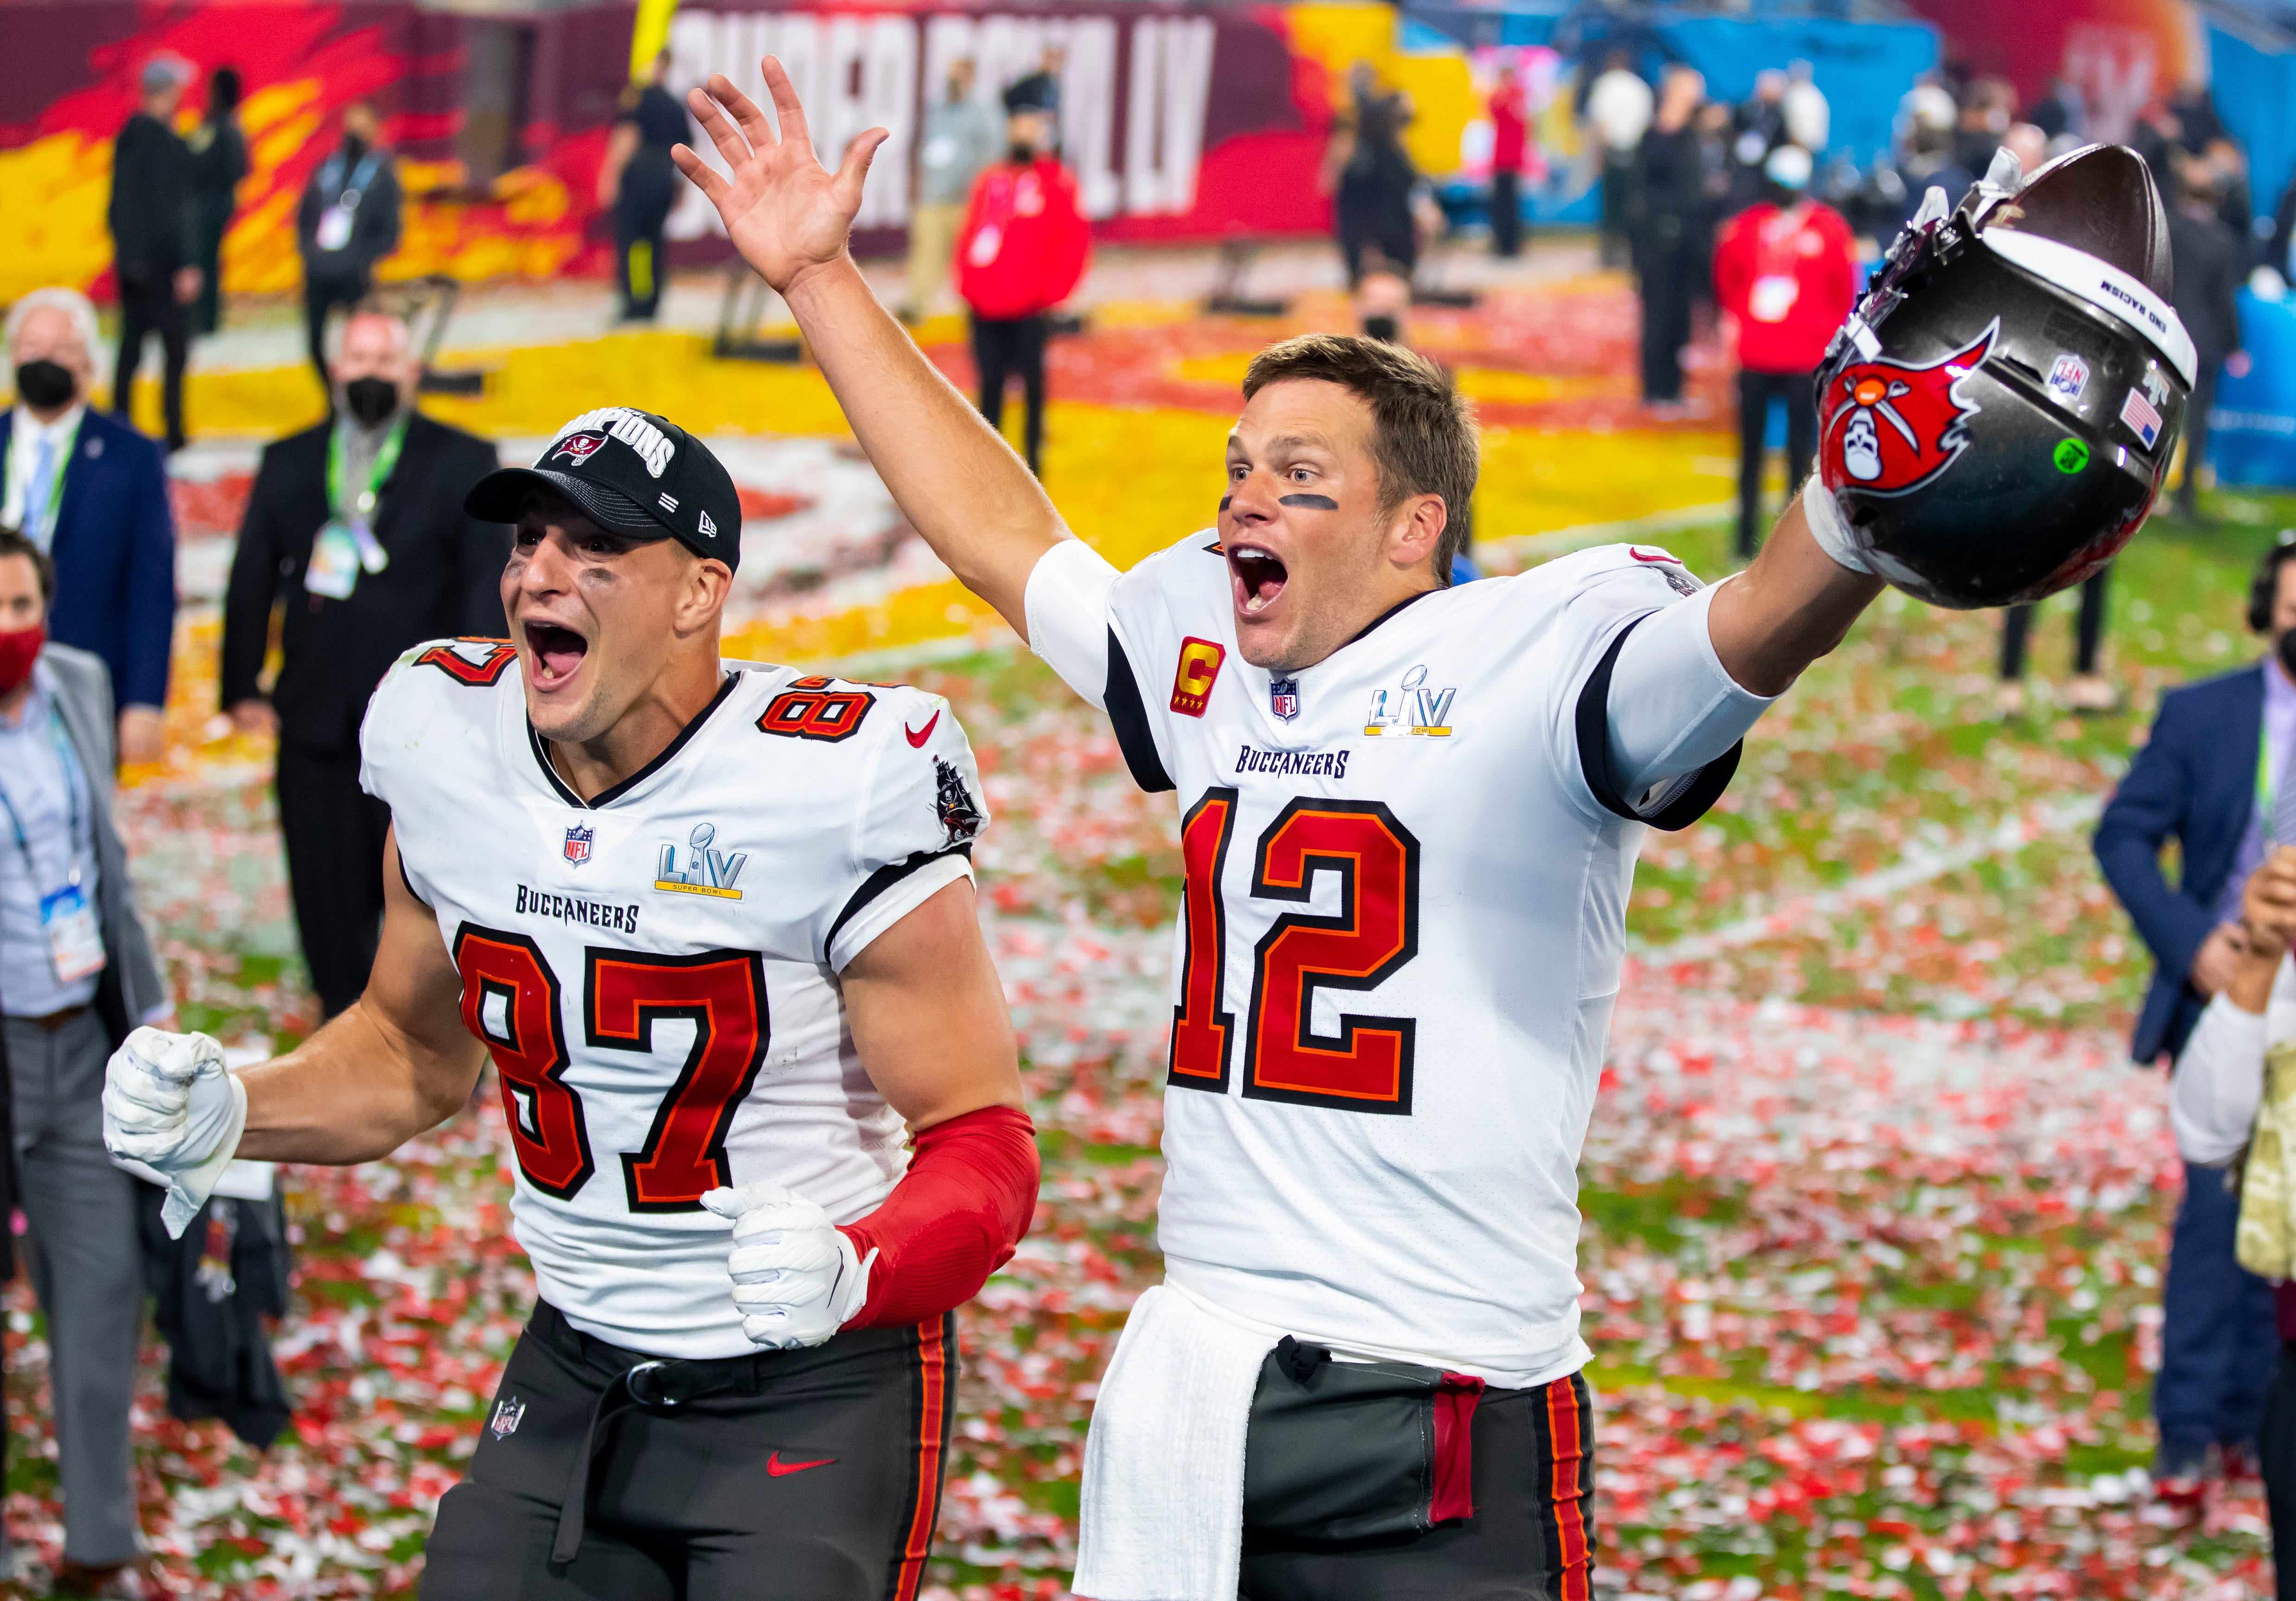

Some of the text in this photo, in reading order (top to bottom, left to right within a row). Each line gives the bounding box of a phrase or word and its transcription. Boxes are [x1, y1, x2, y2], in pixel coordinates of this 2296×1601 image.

[2101, 280, 2166, 333] END RACISM
[2061, 360, 2083, 383] NFL
[1178, 642, 1219, 696] C
[1274, 696, 1296, 716] NFL
[1235, 745, 1350, 779] BUCCANEERS
[566, 841, 588, 860] NFL
[515, 883, 640, 934] BUCCANEERS
[1167, 786, 1421, 1116] 12
[452, 920, 771, 1213] 87
